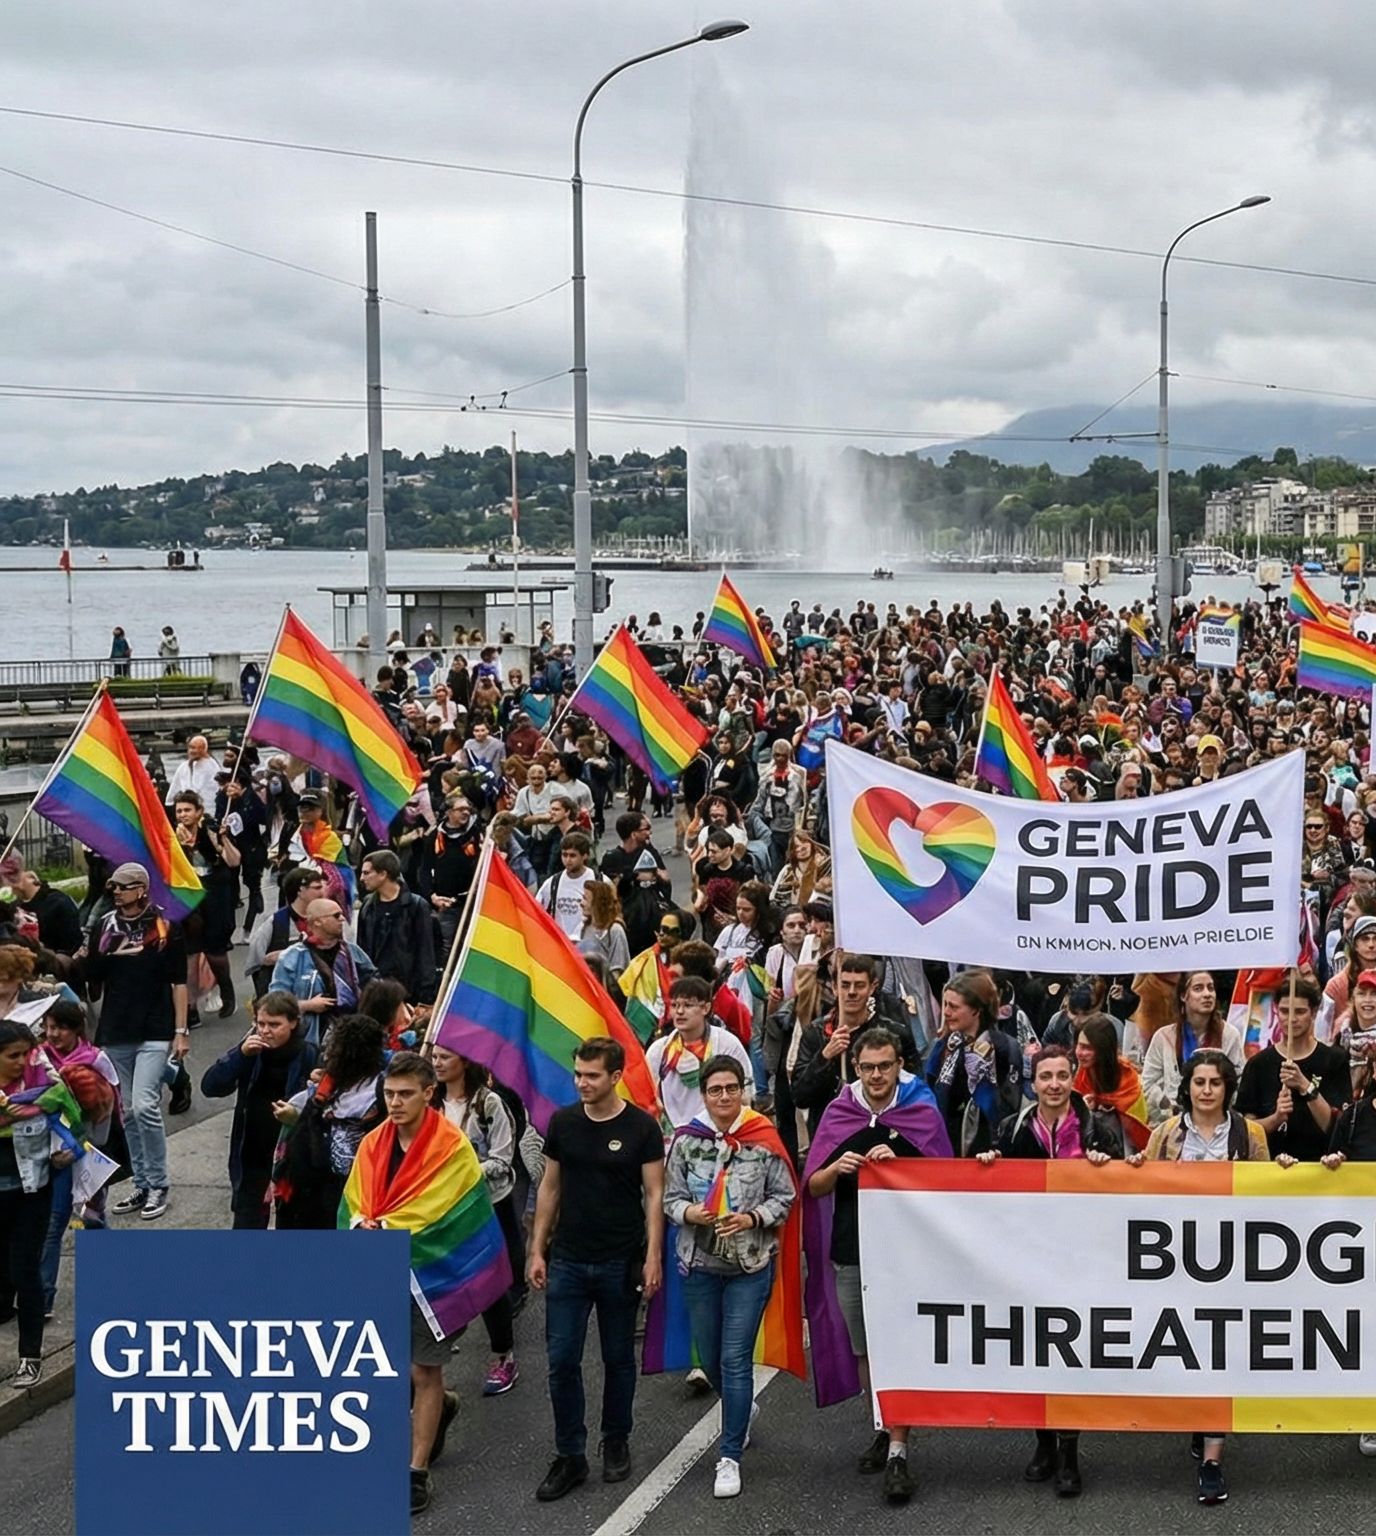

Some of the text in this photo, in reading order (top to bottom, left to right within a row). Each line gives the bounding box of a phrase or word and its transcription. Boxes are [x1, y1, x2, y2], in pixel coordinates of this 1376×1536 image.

[1018, 799, 1273, 857] GENEVA
[1017, 851, 1274, 923] PRIDE
[1120, 935, 1189, 950] NOENVA
[918, 1303, 1361, 1371] THREATEN
